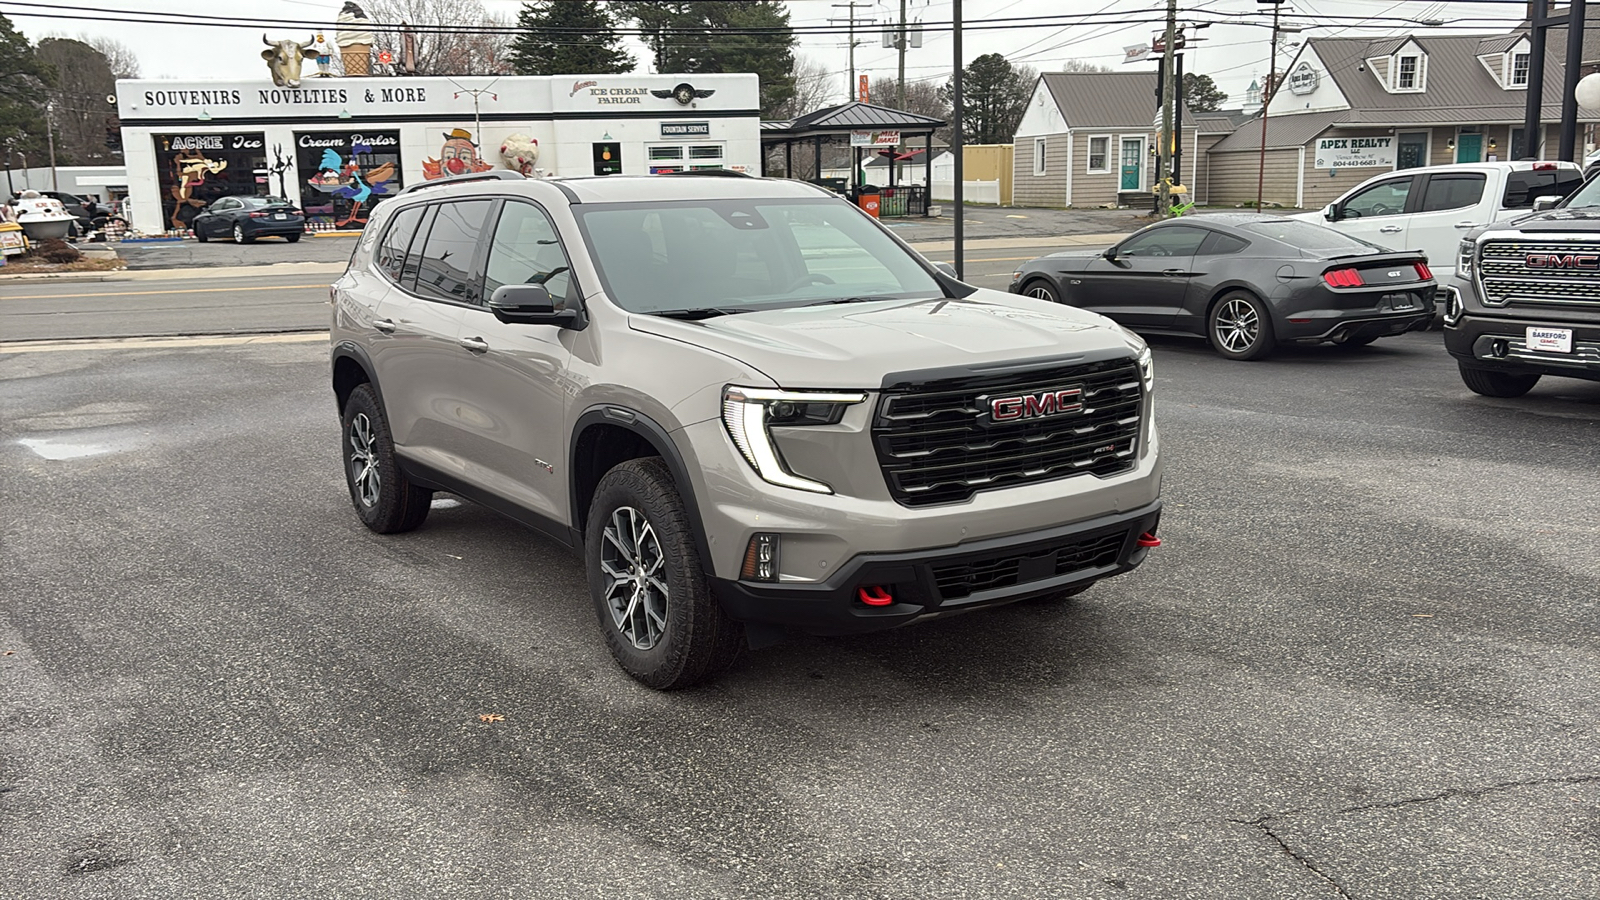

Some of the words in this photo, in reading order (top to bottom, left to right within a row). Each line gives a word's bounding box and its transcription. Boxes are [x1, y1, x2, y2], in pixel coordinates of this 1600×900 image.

[145, 89, 241, 106] SOUVENIRS
[259, 88, 348, 105] NOVELTIES
[364, 88, 375, 103] &
[382, 87, 427, 103] MORE
[590, 88, 607, 96] ICE
[609, 88, 648, 96] CREAM
[662, 126, 687, 134] FOUNTAIN
[687, 125, 708, 133] SERVICE
[171, 136, 224, 150] ACME
[232, 135, 263, 149] Ice
[299, 135, 346, 148] Cream
[350, 134, 398, 147] Parlor
[1320, 139, 1348, 149] APEX
[1350, 138, 1391, 148] REALTY
[1527, 255, 1600, 268] GMC
[1532, 331, 1567, 340] BAREFORD
[991, 388, 1083, 421] GMC
